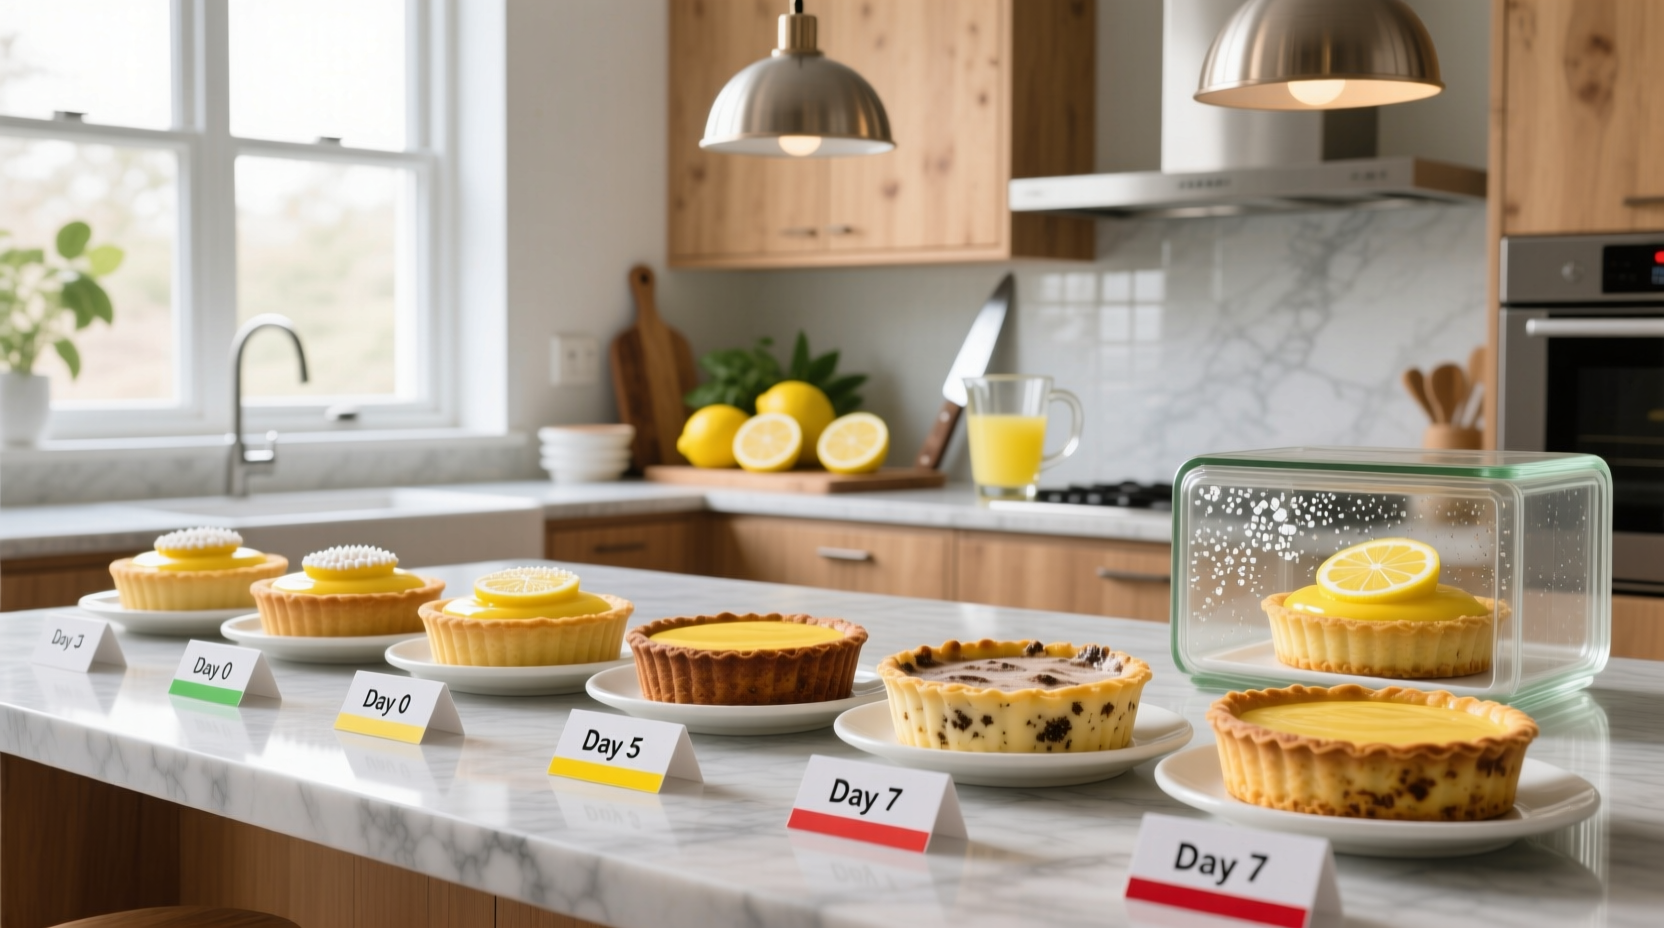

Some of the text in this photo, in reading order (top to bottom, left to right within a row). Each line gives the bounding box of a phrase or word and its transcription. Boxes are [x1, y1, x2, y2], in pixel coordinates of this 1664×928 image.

[193, 656, 233, 682] Day 0
[362, 688, 412, 717] Day 0
[581, 728, 644, 762] Day 5
[828, 778, 904, 816] Day 7
[1174, 842, 1269, 887] Day 7
